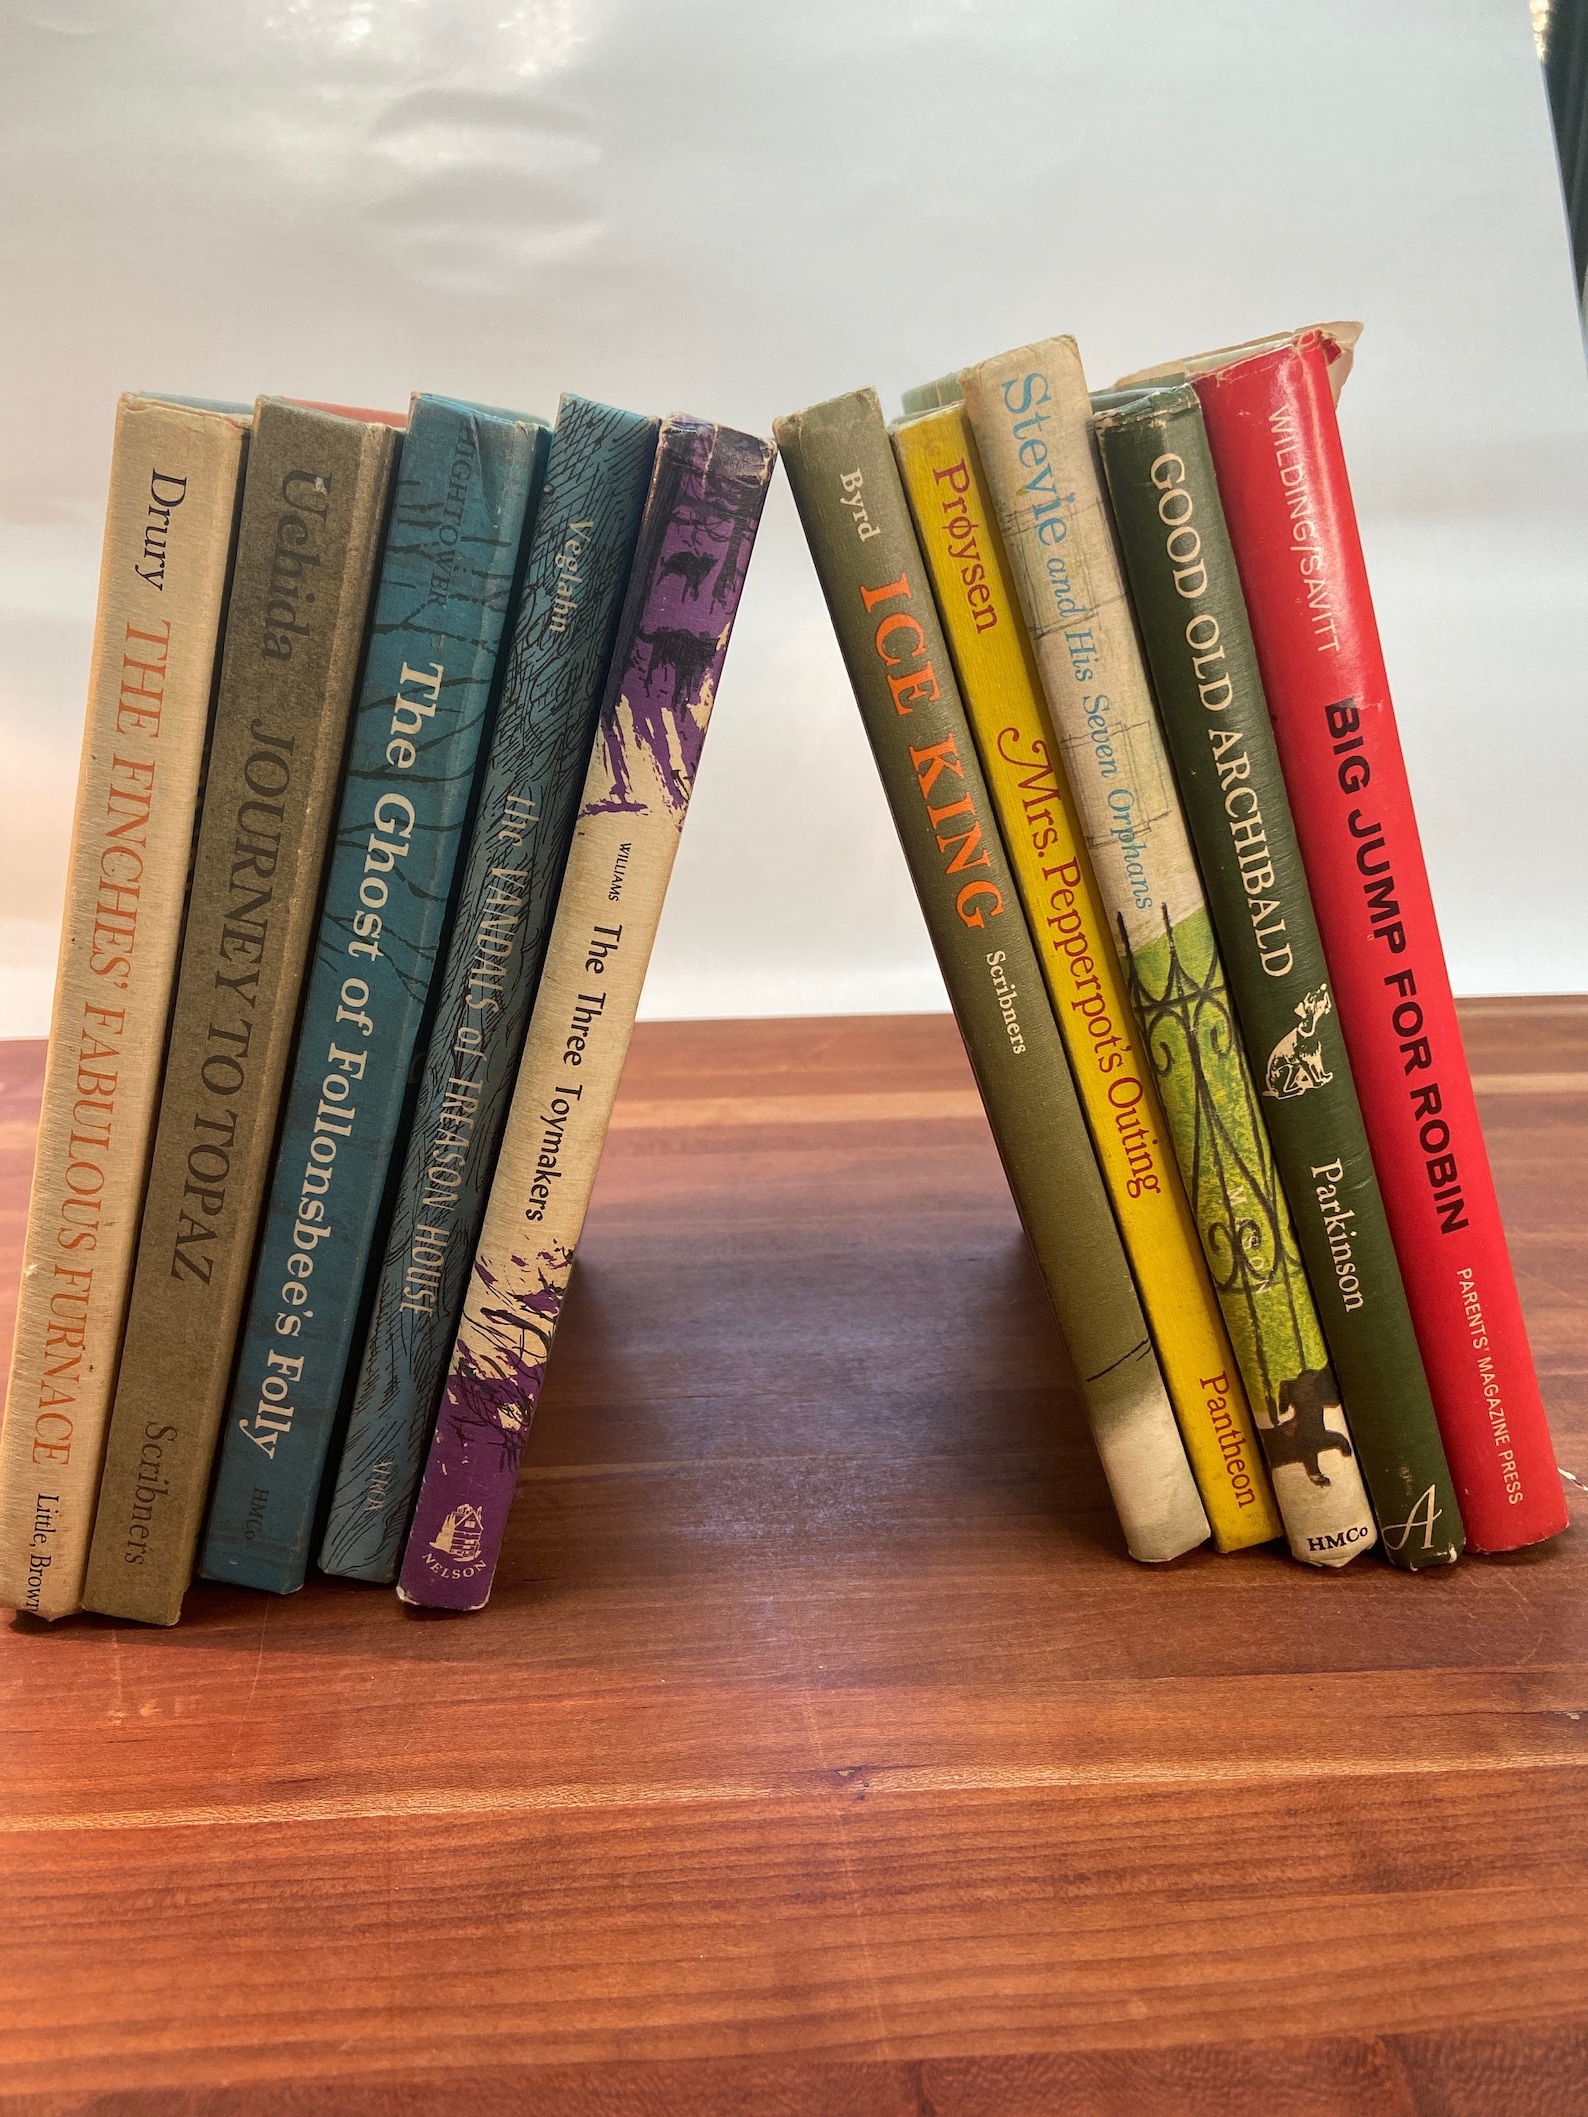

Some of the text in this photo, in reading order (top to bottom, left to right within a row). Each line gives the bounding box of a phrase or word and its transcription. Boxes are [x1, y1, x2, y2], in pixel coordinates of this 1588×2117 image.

[548, 519, 594, 634] Veglahn
[1150, 452, 1208, 601] GOOD
[1001, 370, 1153, 911] Stevie and His Seven Orphans
[1184, 614, 1234, 714] OLD
[499, 796, 538, 846] the
[839, 468, 1027, 1056] Byrd ICE KING Scribners
[1208, 727, 1294, 978] ARCHIBALD
[239, 417, 475, 1541] HIGHTOWER The Ghost of Follonsbee's Folly HMCo
[465, 867, 528, 1013] VANDALS
[932, 457, 1257, 1510] Prøysen Mrs. Pepperpot's Outing Pantheon
[1268, 404, 1523, 1505] WILDING/SAVITT BIG JUMP FOR ROBIN PARENTS' MAGAZINE PRESS
[22, 468, 187, 1612] Drury THE FINCHES' FABULOUS FURNACE Little, Brown
[124, 469, 333, 1566] Uchida JOURNEY TO TOPAZ Scribners
[453, 1026, 489, 1063] of
[525, 842, 632, 1223] WILLIAMS The Three Toymakers
[418, 1075, 483, 1212] TREASON
[400, 1218, 450, 1318] HOUSE
[1227, 1184, 1272, 1294] MASON
[1310, 1157, 1364, 1313] Parkinson
[422, 1553, 486, 1578] NELSON
[1306, 1526, 1368, 1553] HMCo
